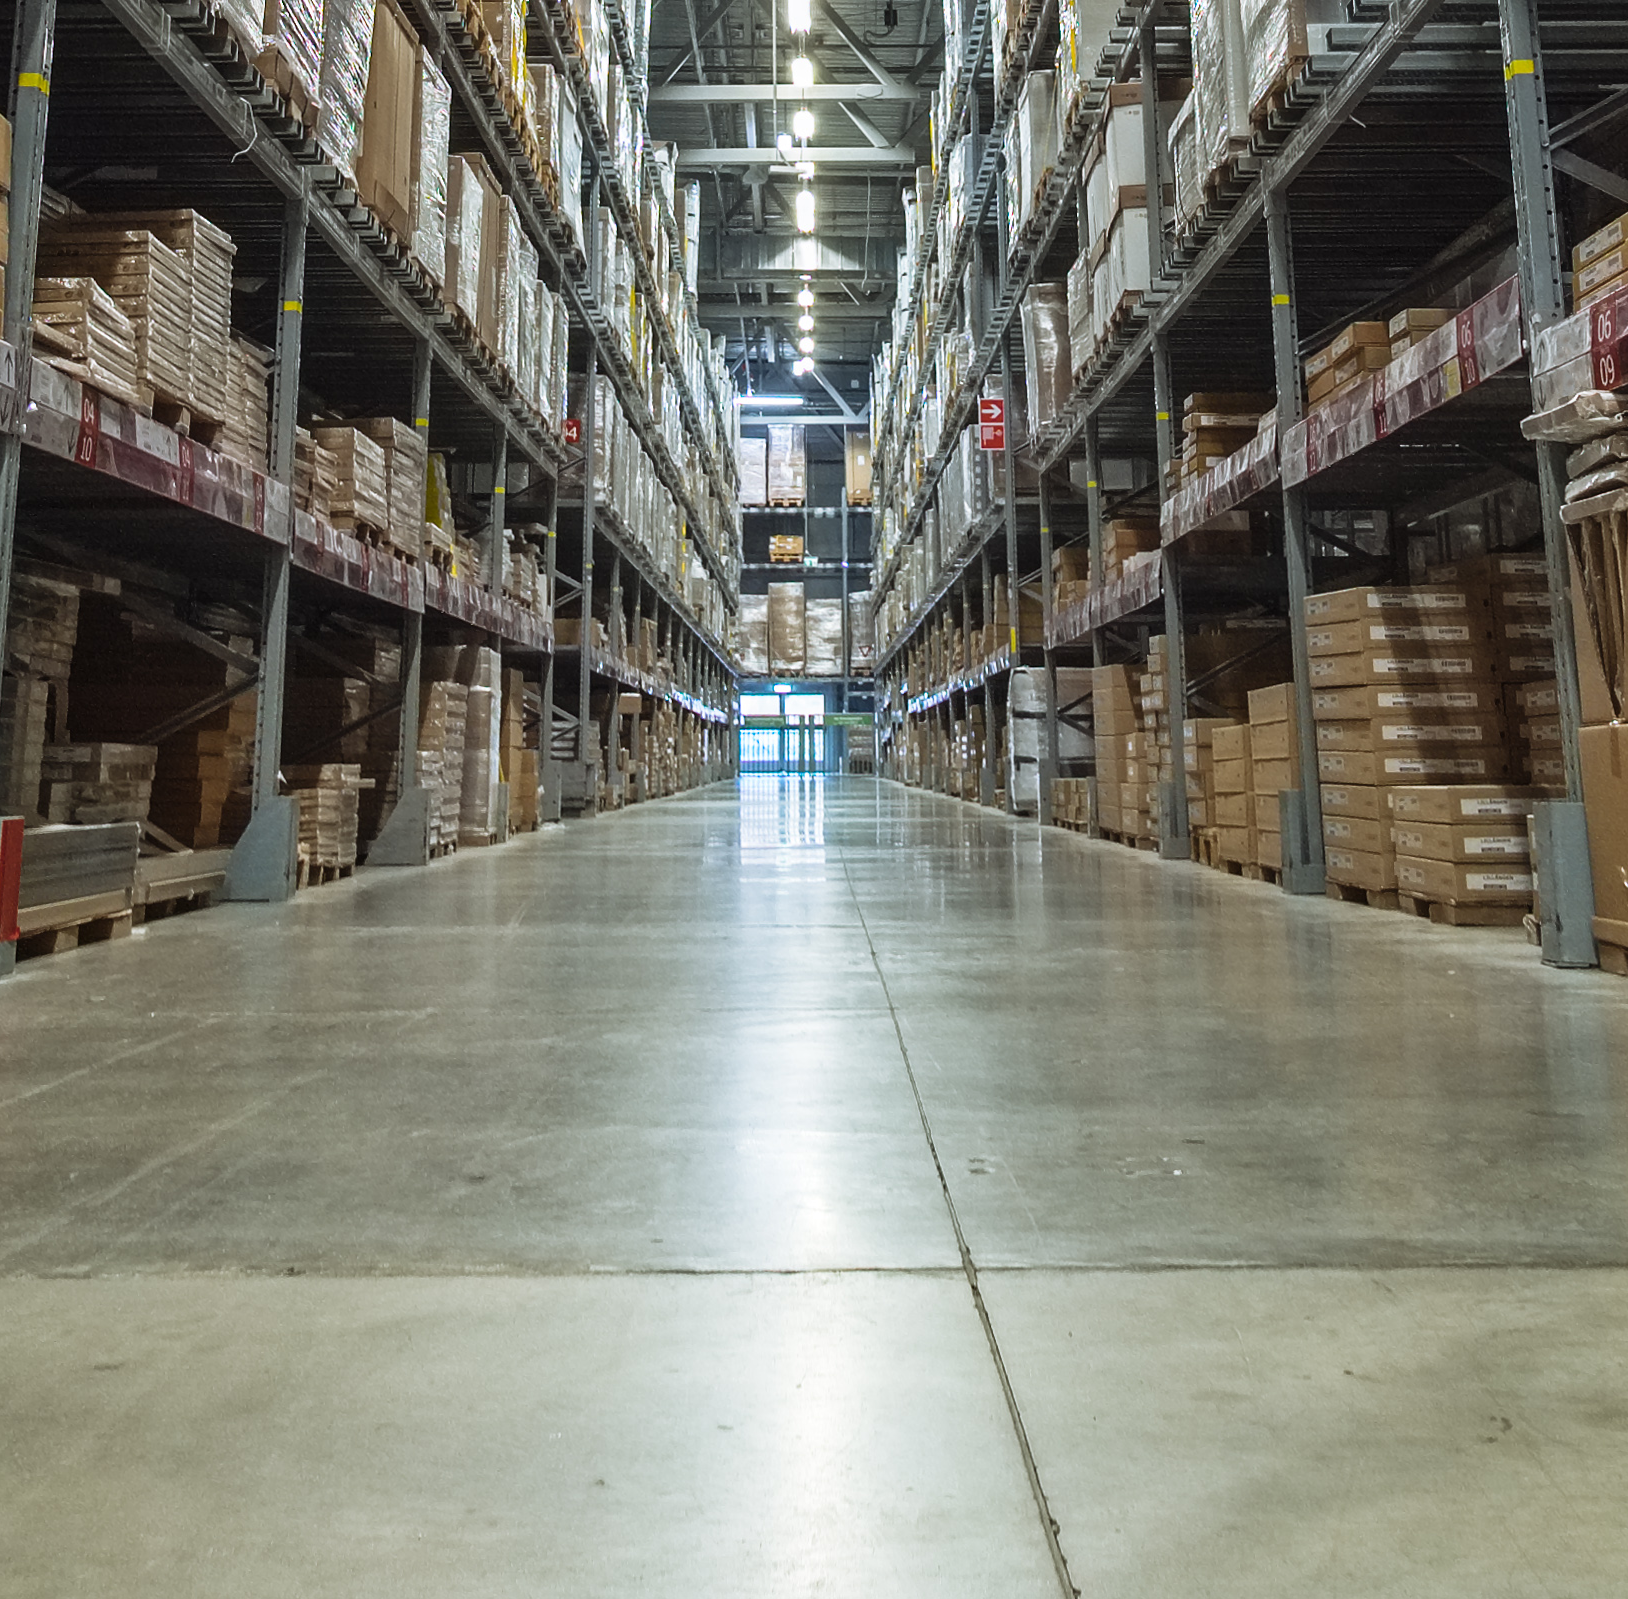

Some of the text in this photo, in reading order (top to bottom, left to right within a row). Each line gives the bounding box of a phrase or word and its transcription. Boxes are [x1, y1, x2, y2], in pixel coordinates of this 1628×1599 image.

[1461, 320, 1473, 349] 06
[1597, 309, 1612, 343] 06
[1464, 358, 1475, 385] 10
[1599, 353, 1615, 387] 09
[84, 398, 95, 424] 04
[80, 437, 93, 463] 10
